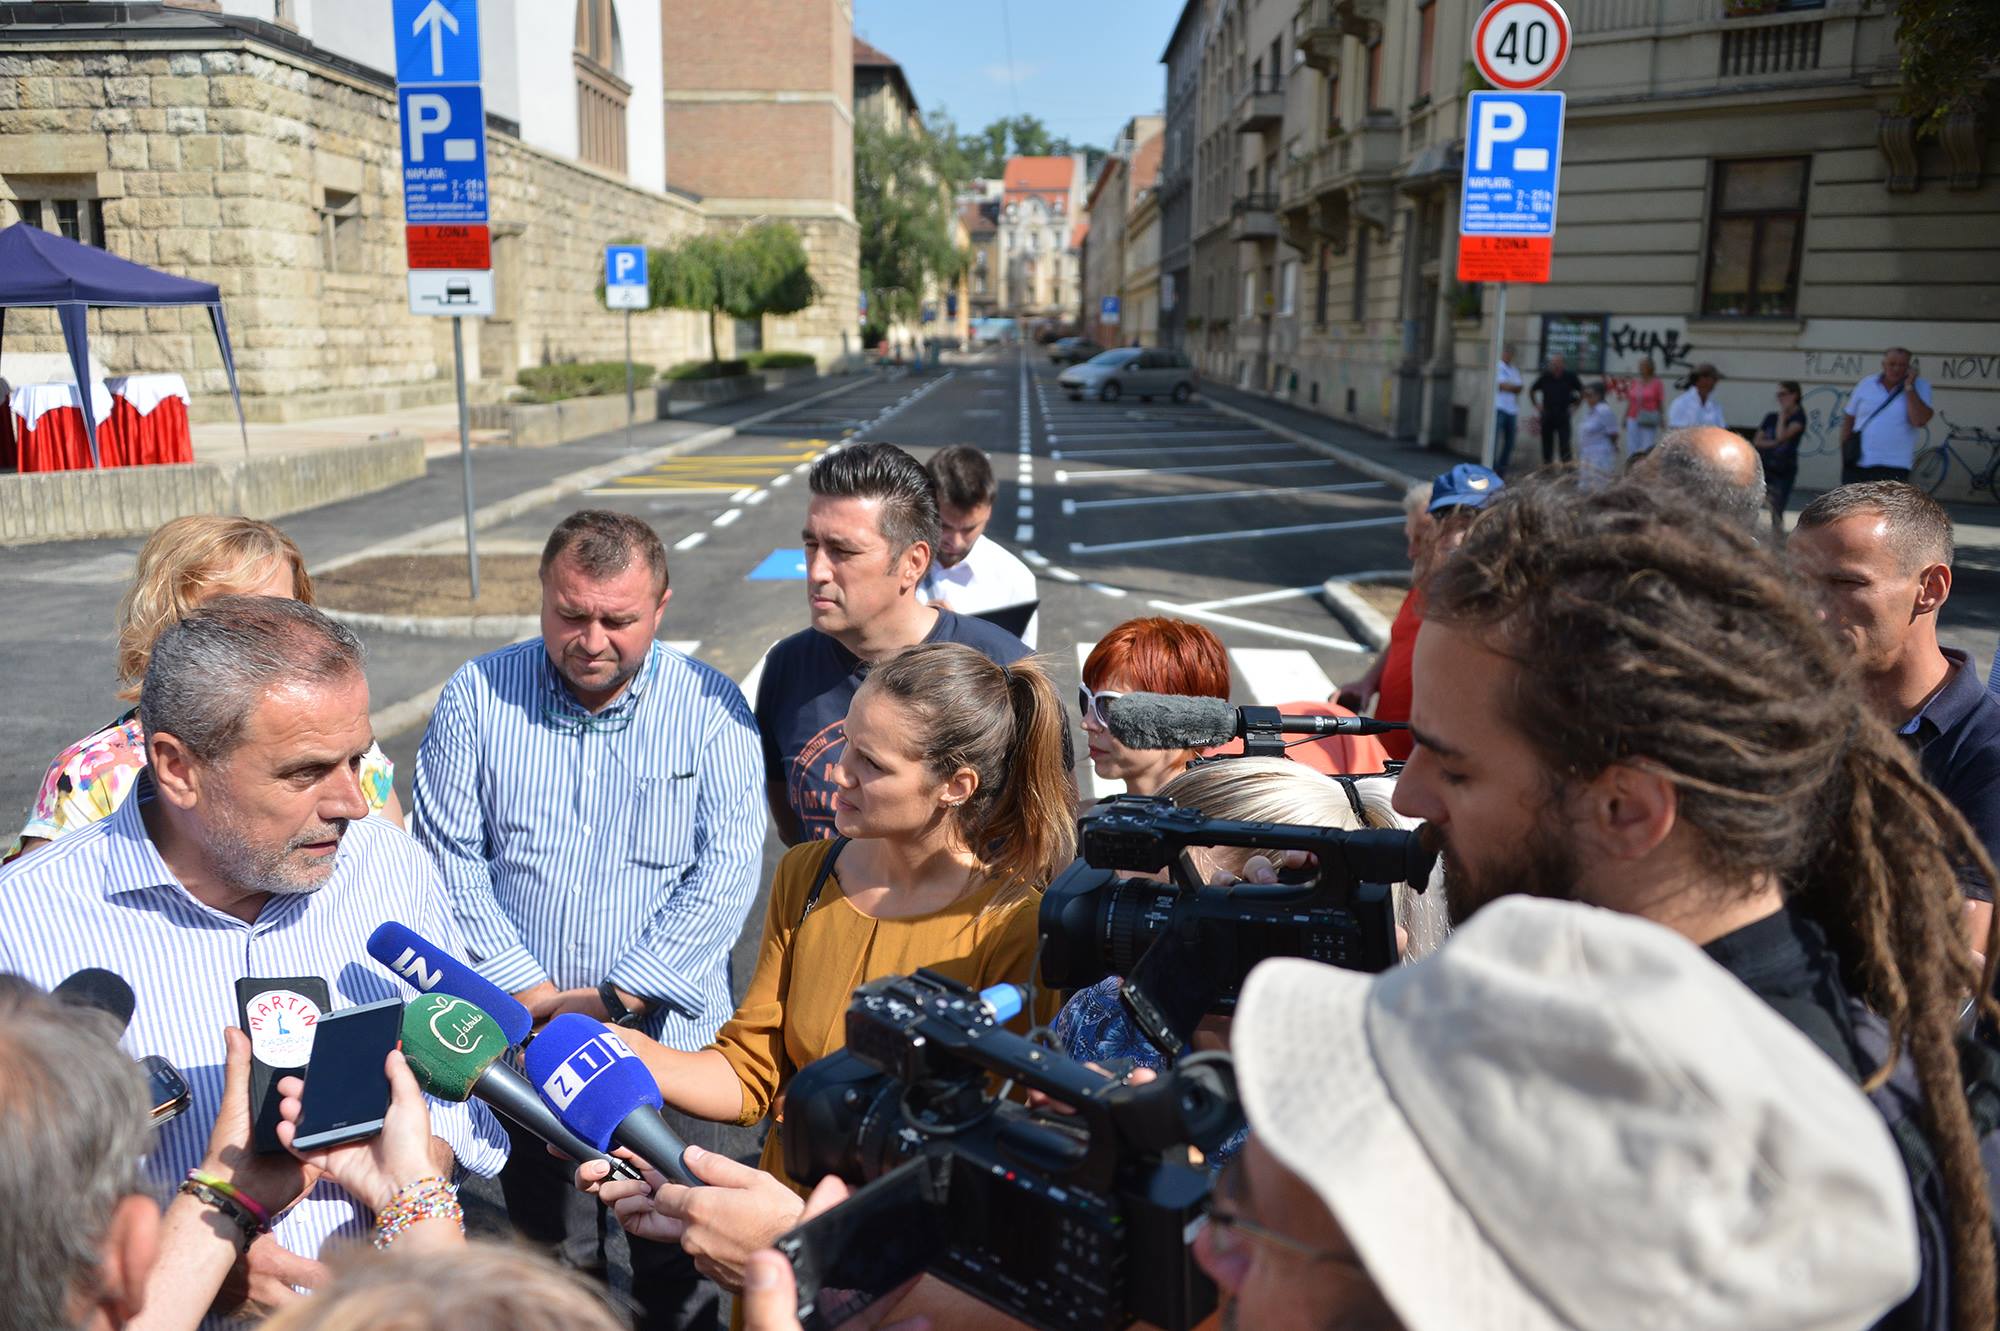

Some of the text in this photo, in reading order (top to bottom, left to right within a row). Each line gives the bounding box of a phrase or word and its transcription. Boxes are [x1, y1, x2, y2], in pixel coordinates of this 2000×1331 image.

[1495, 21, 1547, 65] 40
[407, 94, 452, 162] P
[1476, 101, 1528, 171] P
[437, 226, 469, 239] ZONA
[1494, 238, 1529, 250] ZONA
[615, 252, 636, 280] P
[1804, 352, 1863, 376] PLAN
[1941, 355, 2000, 380] NOV
[250, 996, 319, 1031] MARTIN
